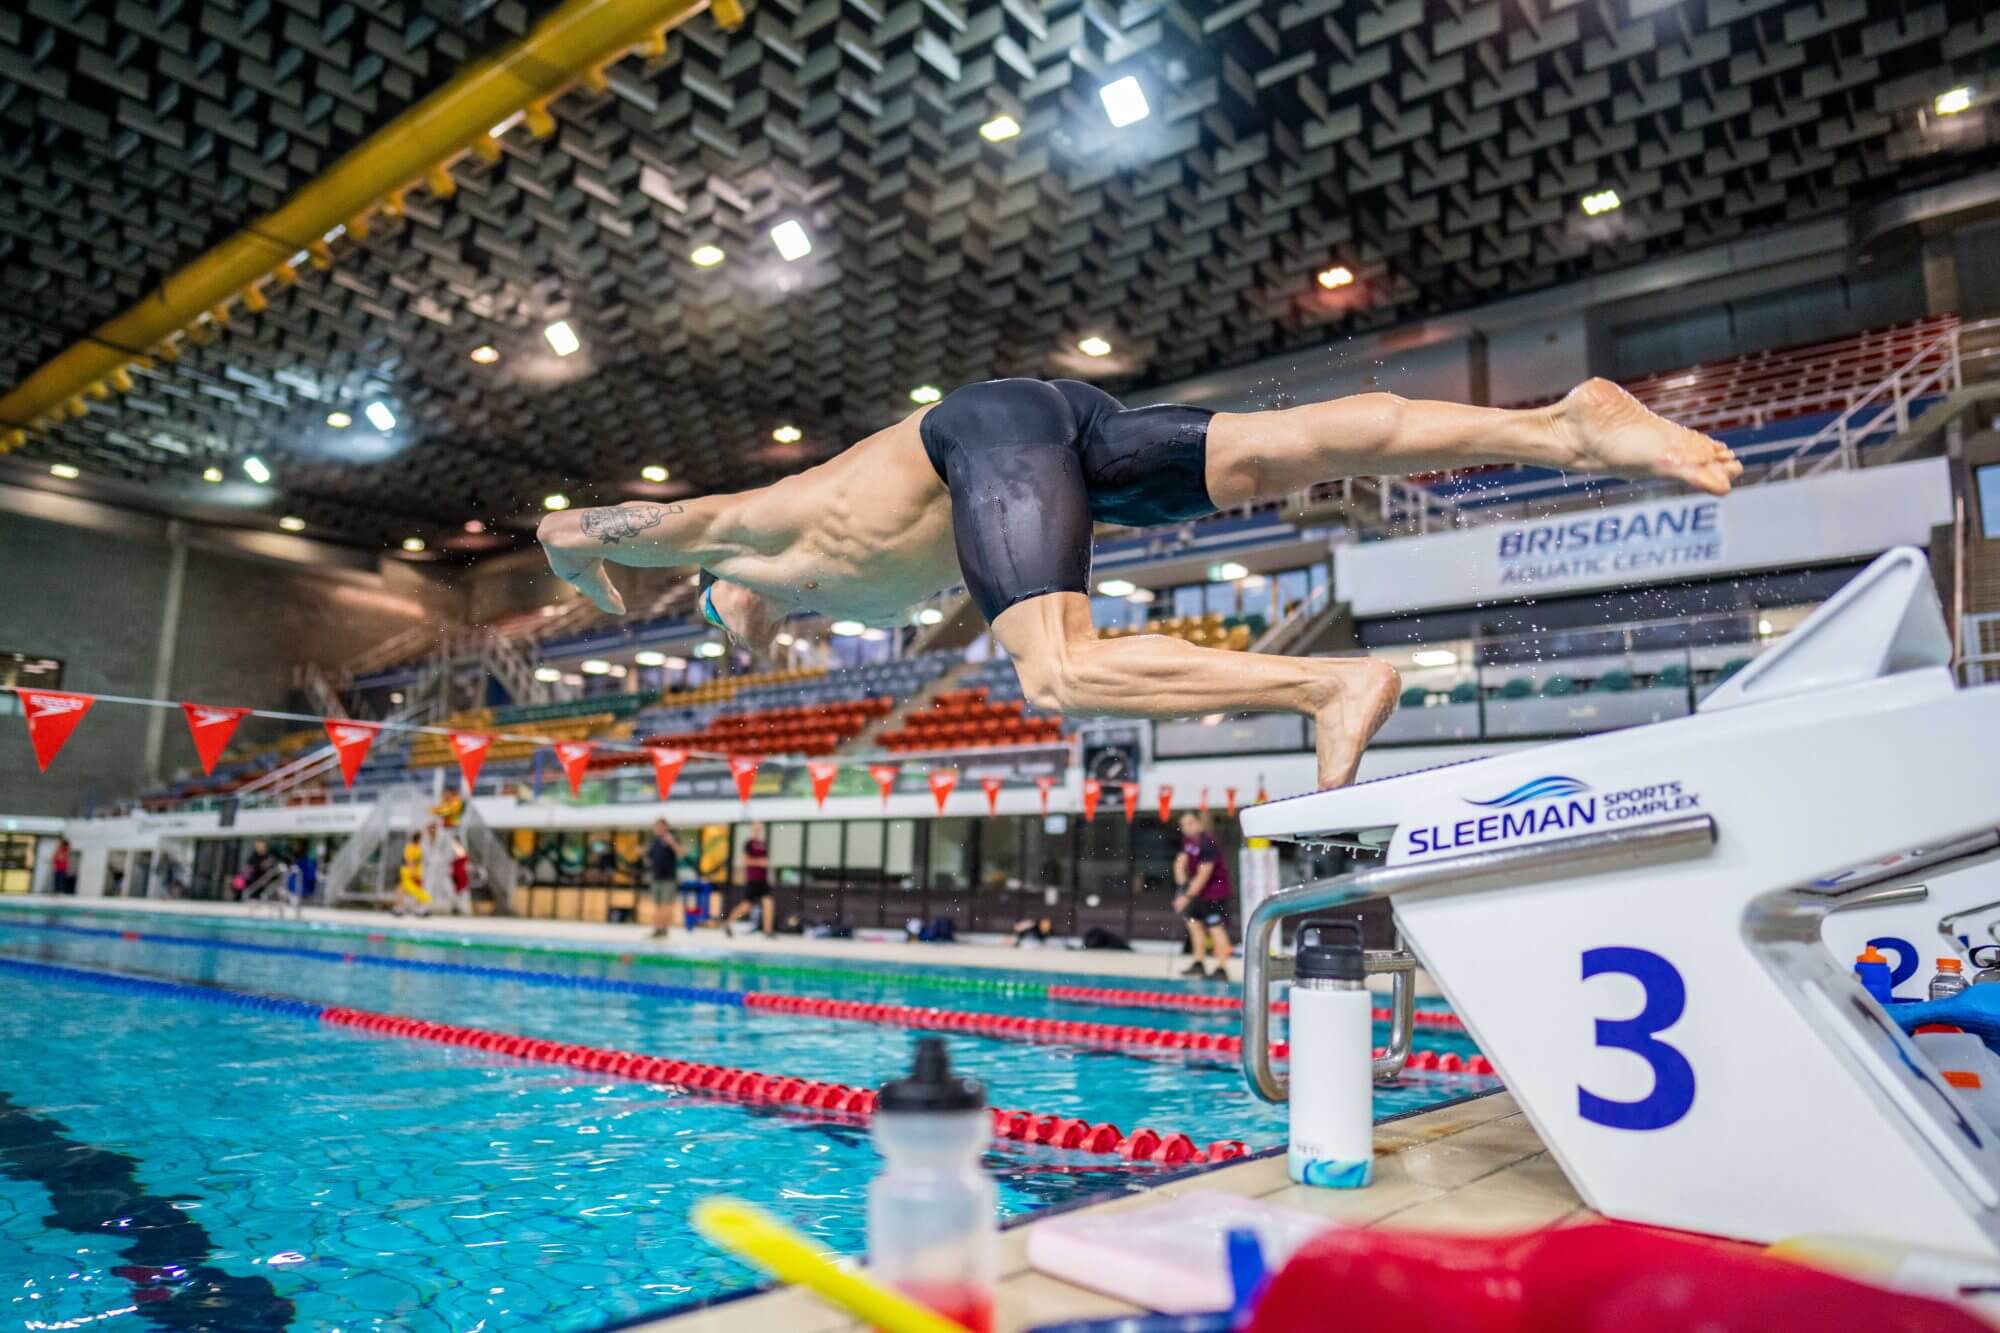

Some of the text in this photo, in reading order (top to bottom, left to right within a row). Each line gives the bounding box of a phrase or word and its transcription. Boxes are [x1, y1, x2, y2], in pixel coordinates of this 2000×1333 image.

[1498, 503, 1719, 557] BRISBANE
[1501, 542, 1719, 584] AQUATIC CENTRE
[1603, 780, 1683, 807] SPORTS
[1408, 793, 1700, 856] SLEEMAN COMPLEX
[1577, 946, 1696, 1131] 3
